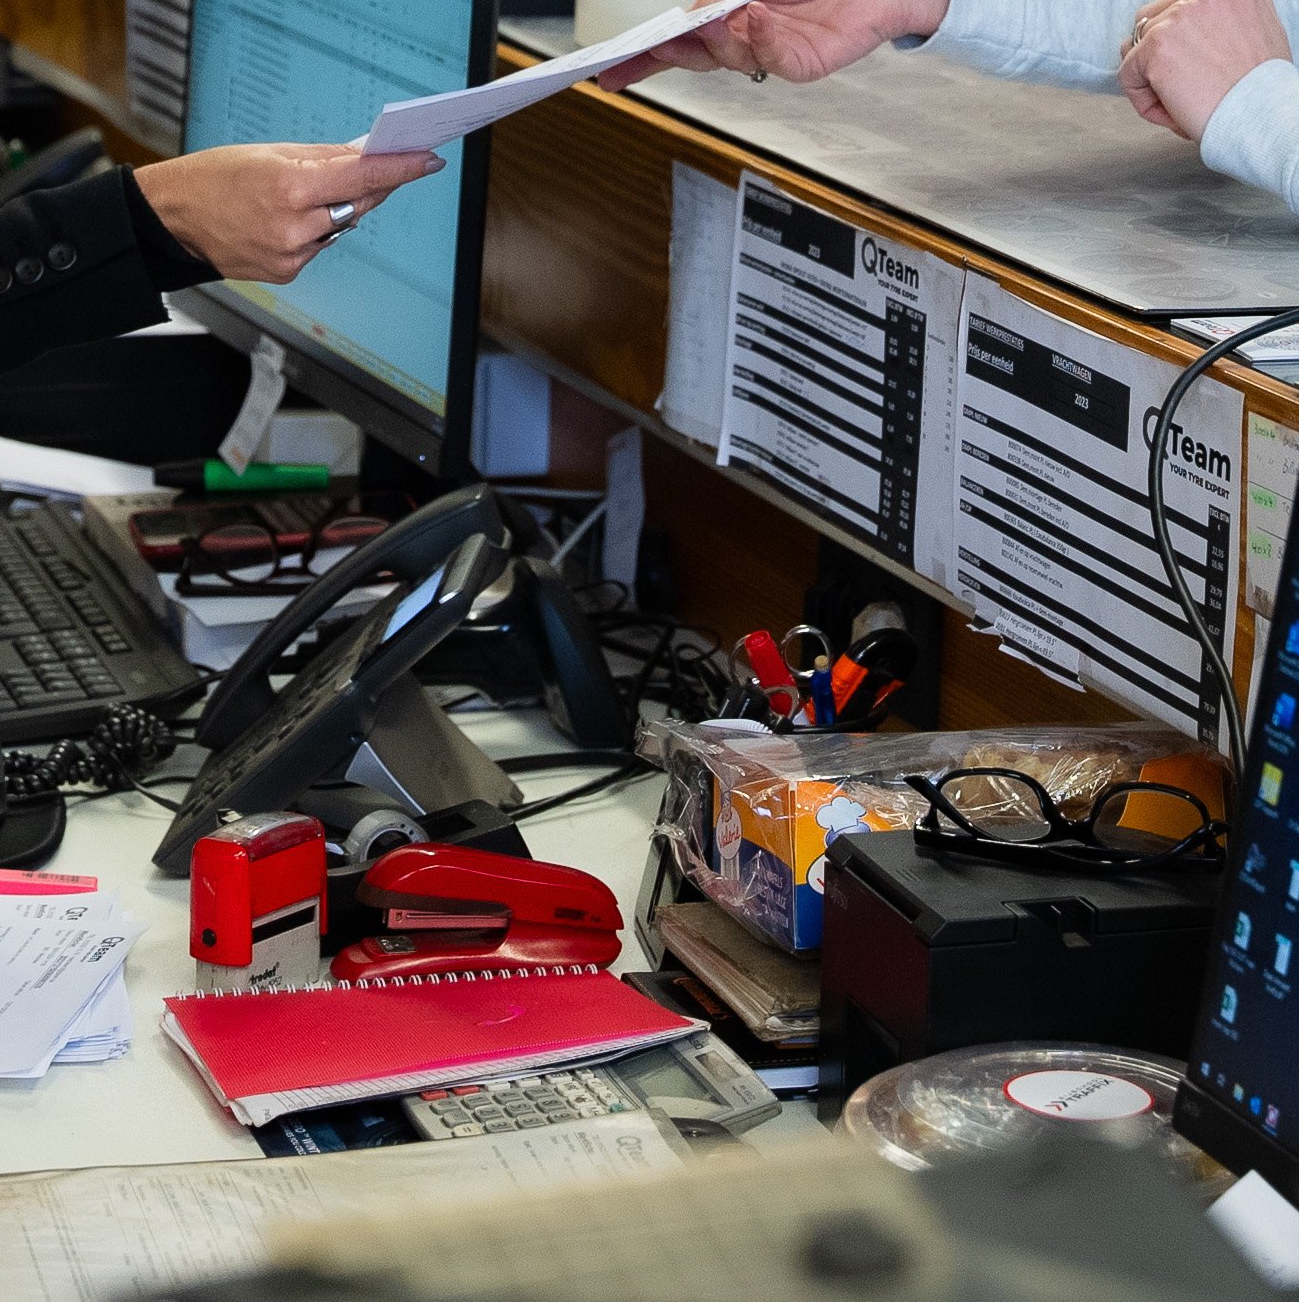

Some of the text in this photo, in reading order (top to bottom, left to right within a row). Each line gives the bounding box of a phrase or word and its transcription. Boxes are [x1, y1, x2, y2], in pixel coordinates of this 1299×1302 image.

[861, 236, 919, 290] QTeam
[968, 342, 1014, 373] Prijs per eenheid
[1052, 354, 1092, 382] VRACHTWAGEN
[1075, 393, 1089, 409] 2023
[1142, 405, 1231, 482] QTeam
[1169, 462, 1230, 500] YOUR TYRE EXPERT
